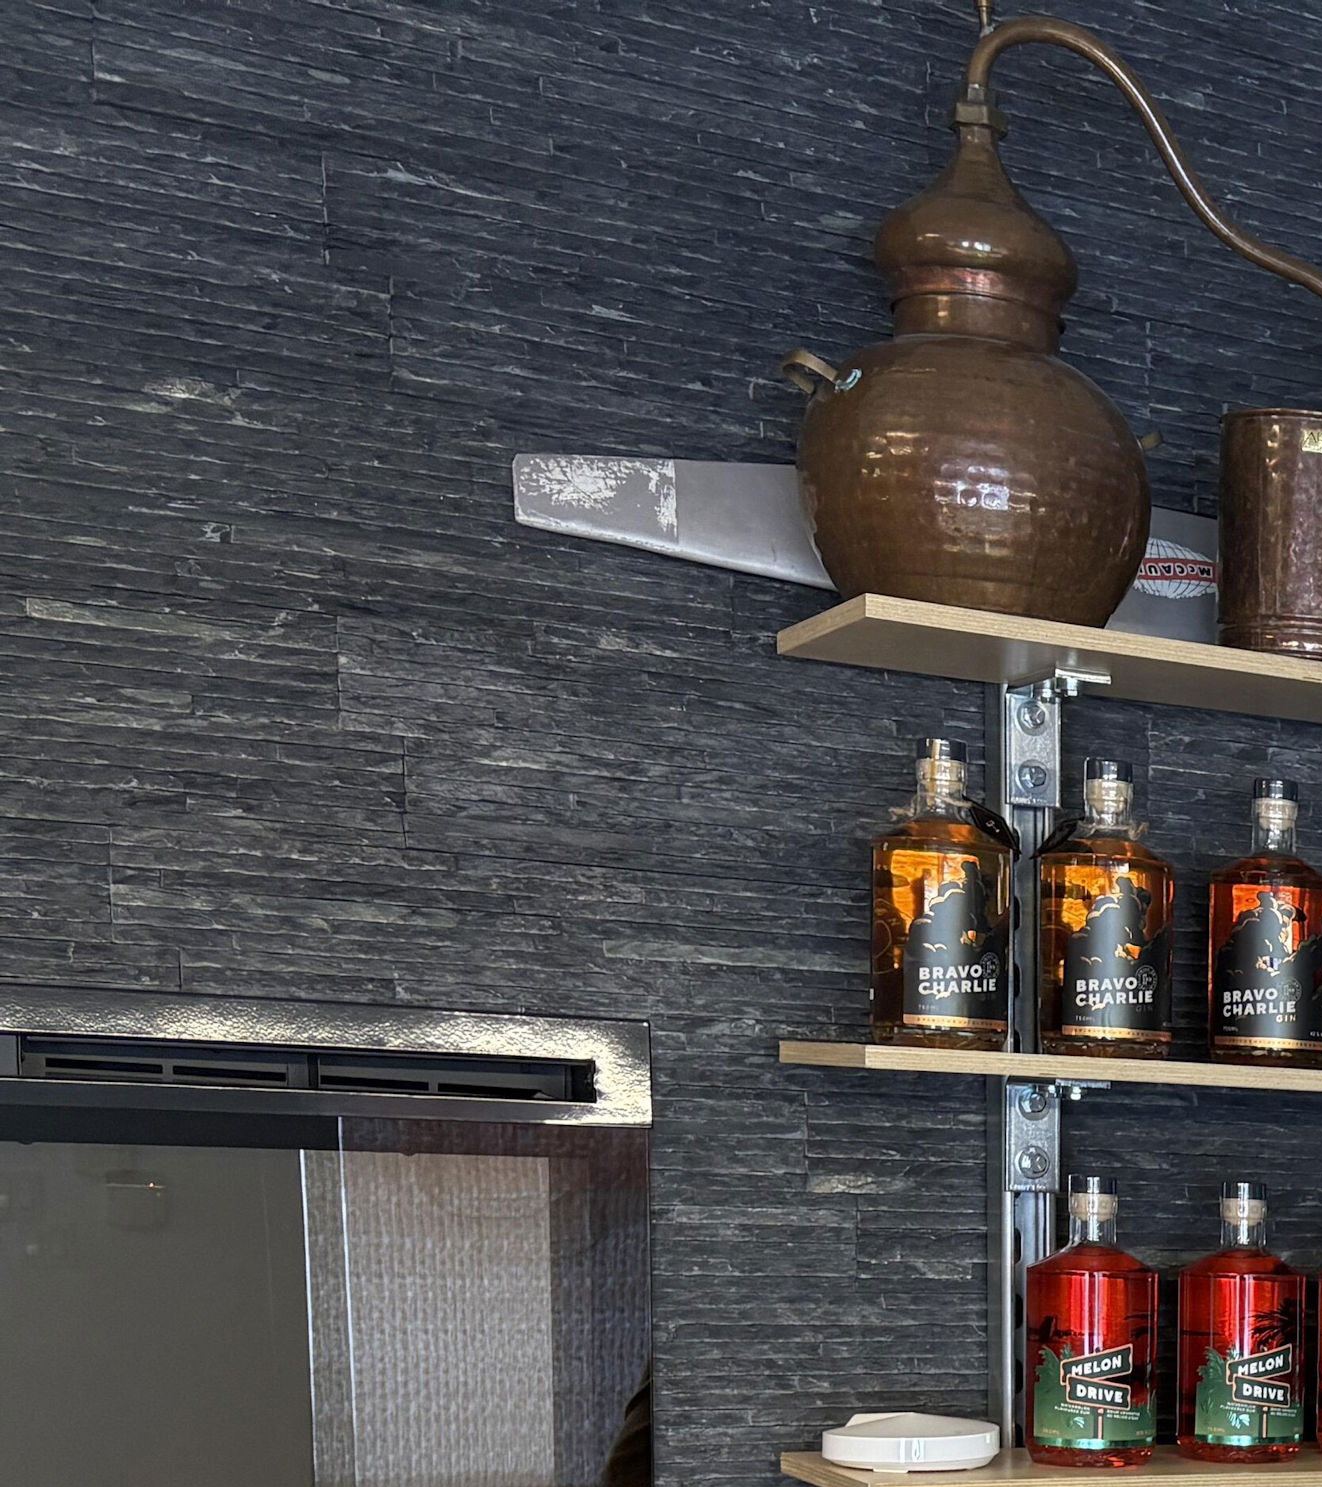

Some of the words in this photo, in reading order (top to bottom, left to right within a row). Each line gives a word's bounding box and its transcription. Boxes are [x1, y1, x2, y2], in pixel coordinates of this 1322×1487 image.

[918, 965, 983, 980] BRAVO
[918, 978, 997, 996] CHARLIE
[1076, 977, 1138, 993] BRAVO
[1075, 990, 1153, 1007] CHARLIE
[1223, 988, 1278, 1004] BRAVO
[1223, 1001, 1296, 1017] CHARLIE
[1276, 1014, 1296, 1023] GIN
[1071, 1355, 1122, 1376] MELON
[1238, 1354, 1283, 1375] MELON
[1076, 1384, 1123, 1403] DRIVE
[1243, 1383, 1284, 1401] DRIVE
